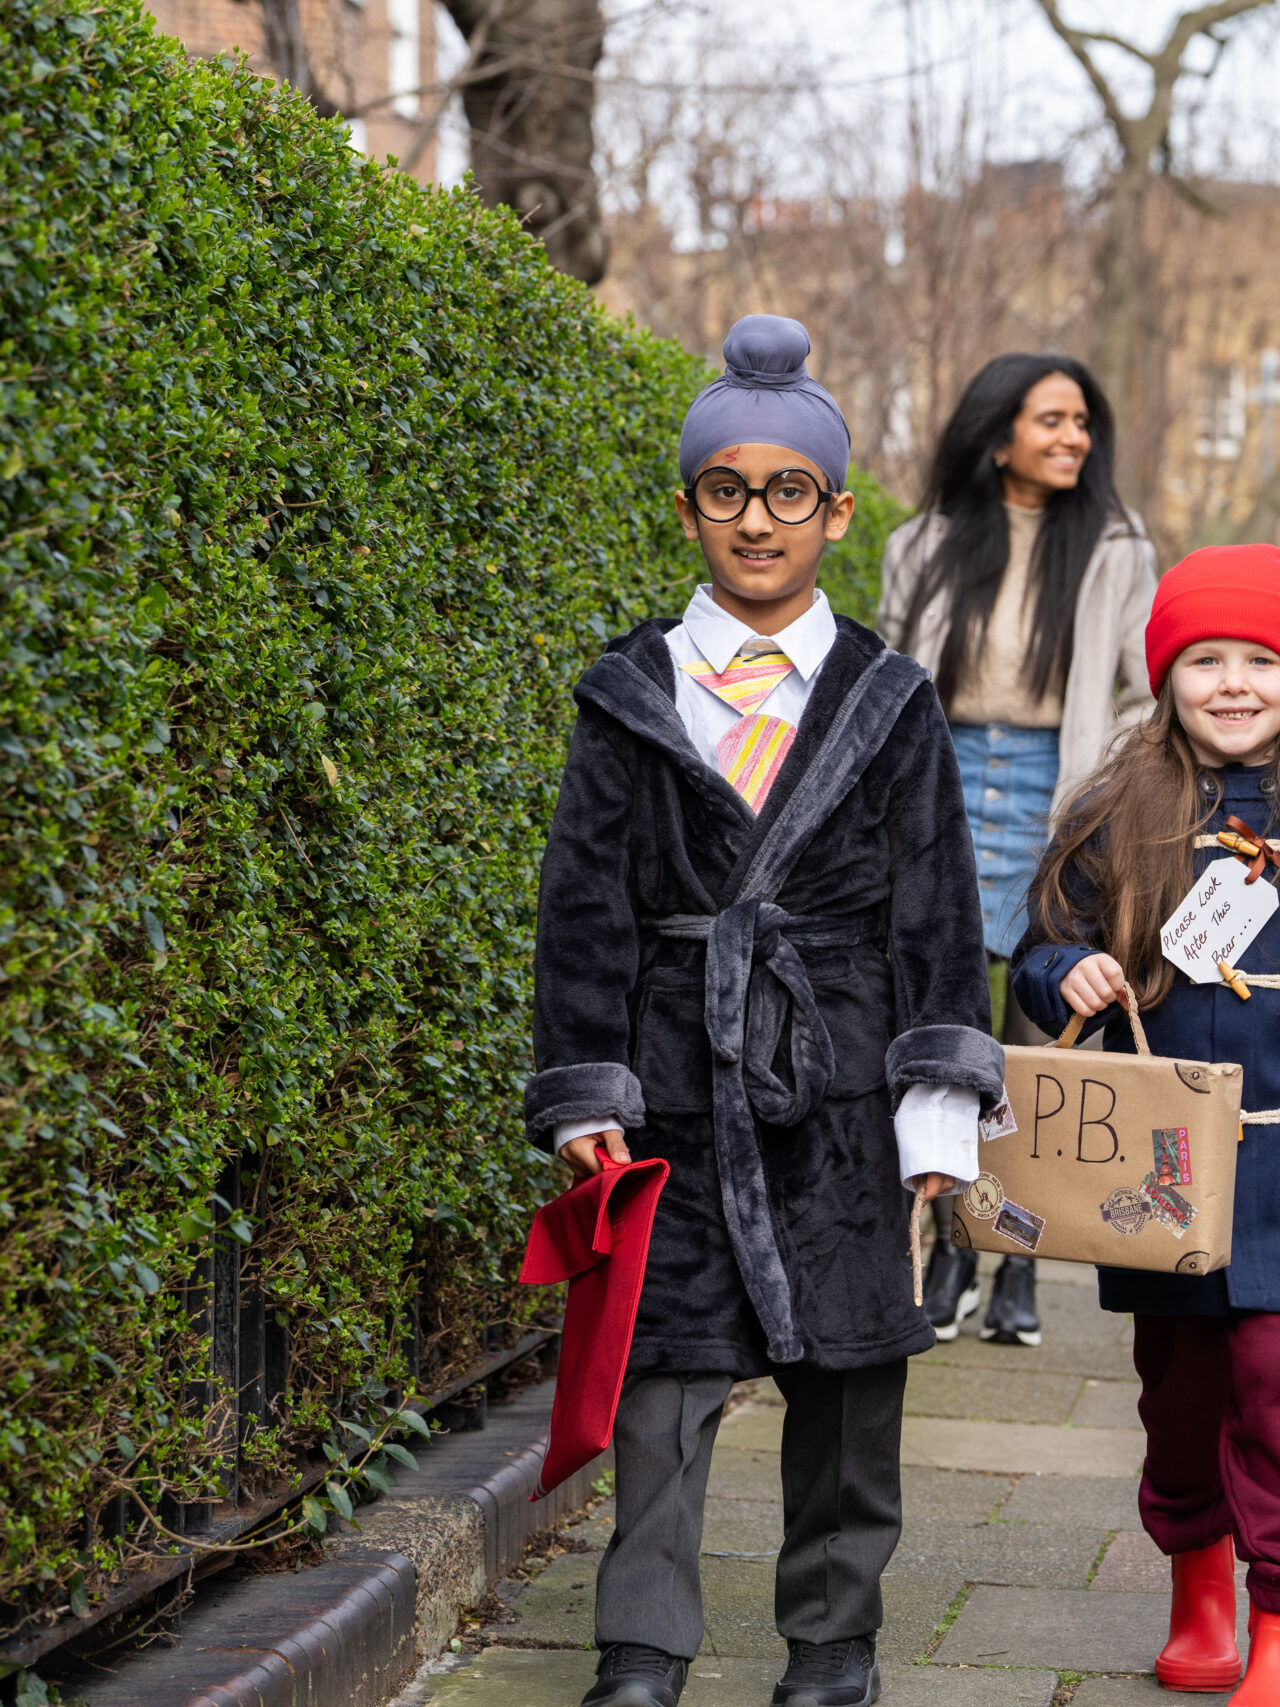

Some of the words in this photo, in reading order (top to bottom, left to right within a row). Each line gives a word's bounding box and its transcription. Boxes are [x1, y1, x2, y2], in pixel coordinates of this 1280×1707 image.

[1163, 911, 1197, 951] Please
[1199, 876, 1222, 908] Look
[1183, 930, 1208, 960] After
[1211, 901, 1231, 926] This
[1178, 1129, 1190, 1183] PARIS
[1110, 1204, 1143, 1219] BRISBANE
[1145, 1184, 1186, 1223] LONDON
